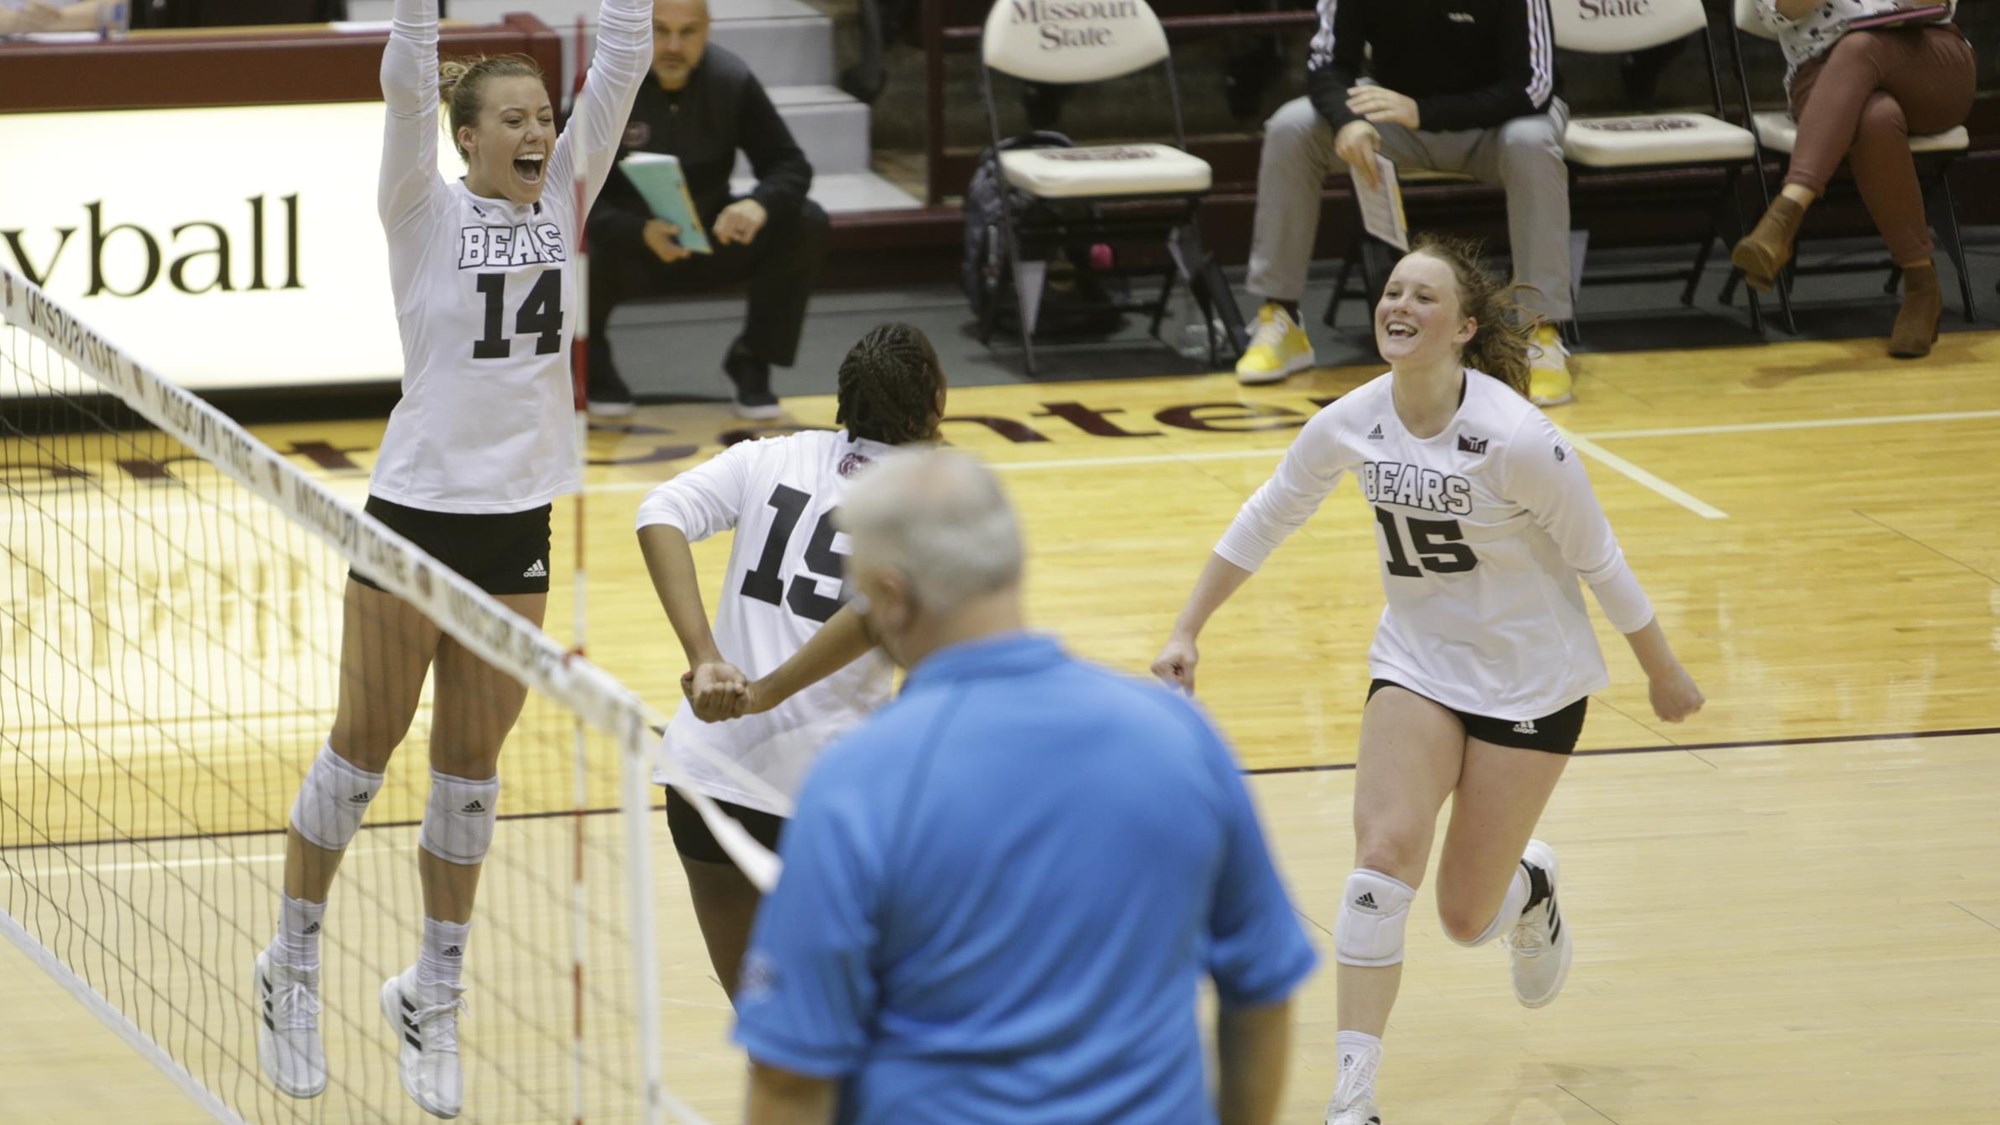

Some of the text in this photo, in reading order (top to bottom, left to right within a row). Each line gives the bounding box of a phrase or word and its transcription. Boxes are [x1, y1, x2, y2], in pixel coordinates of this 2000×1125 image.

[1039, 24, 1112, 50] State
[458, 222, 566, 270] BEAS
[472, 268, 564, 359] 14
[1363, 461, 1472, 516] BEARS
[1374, 505, 1479, 578] 15
